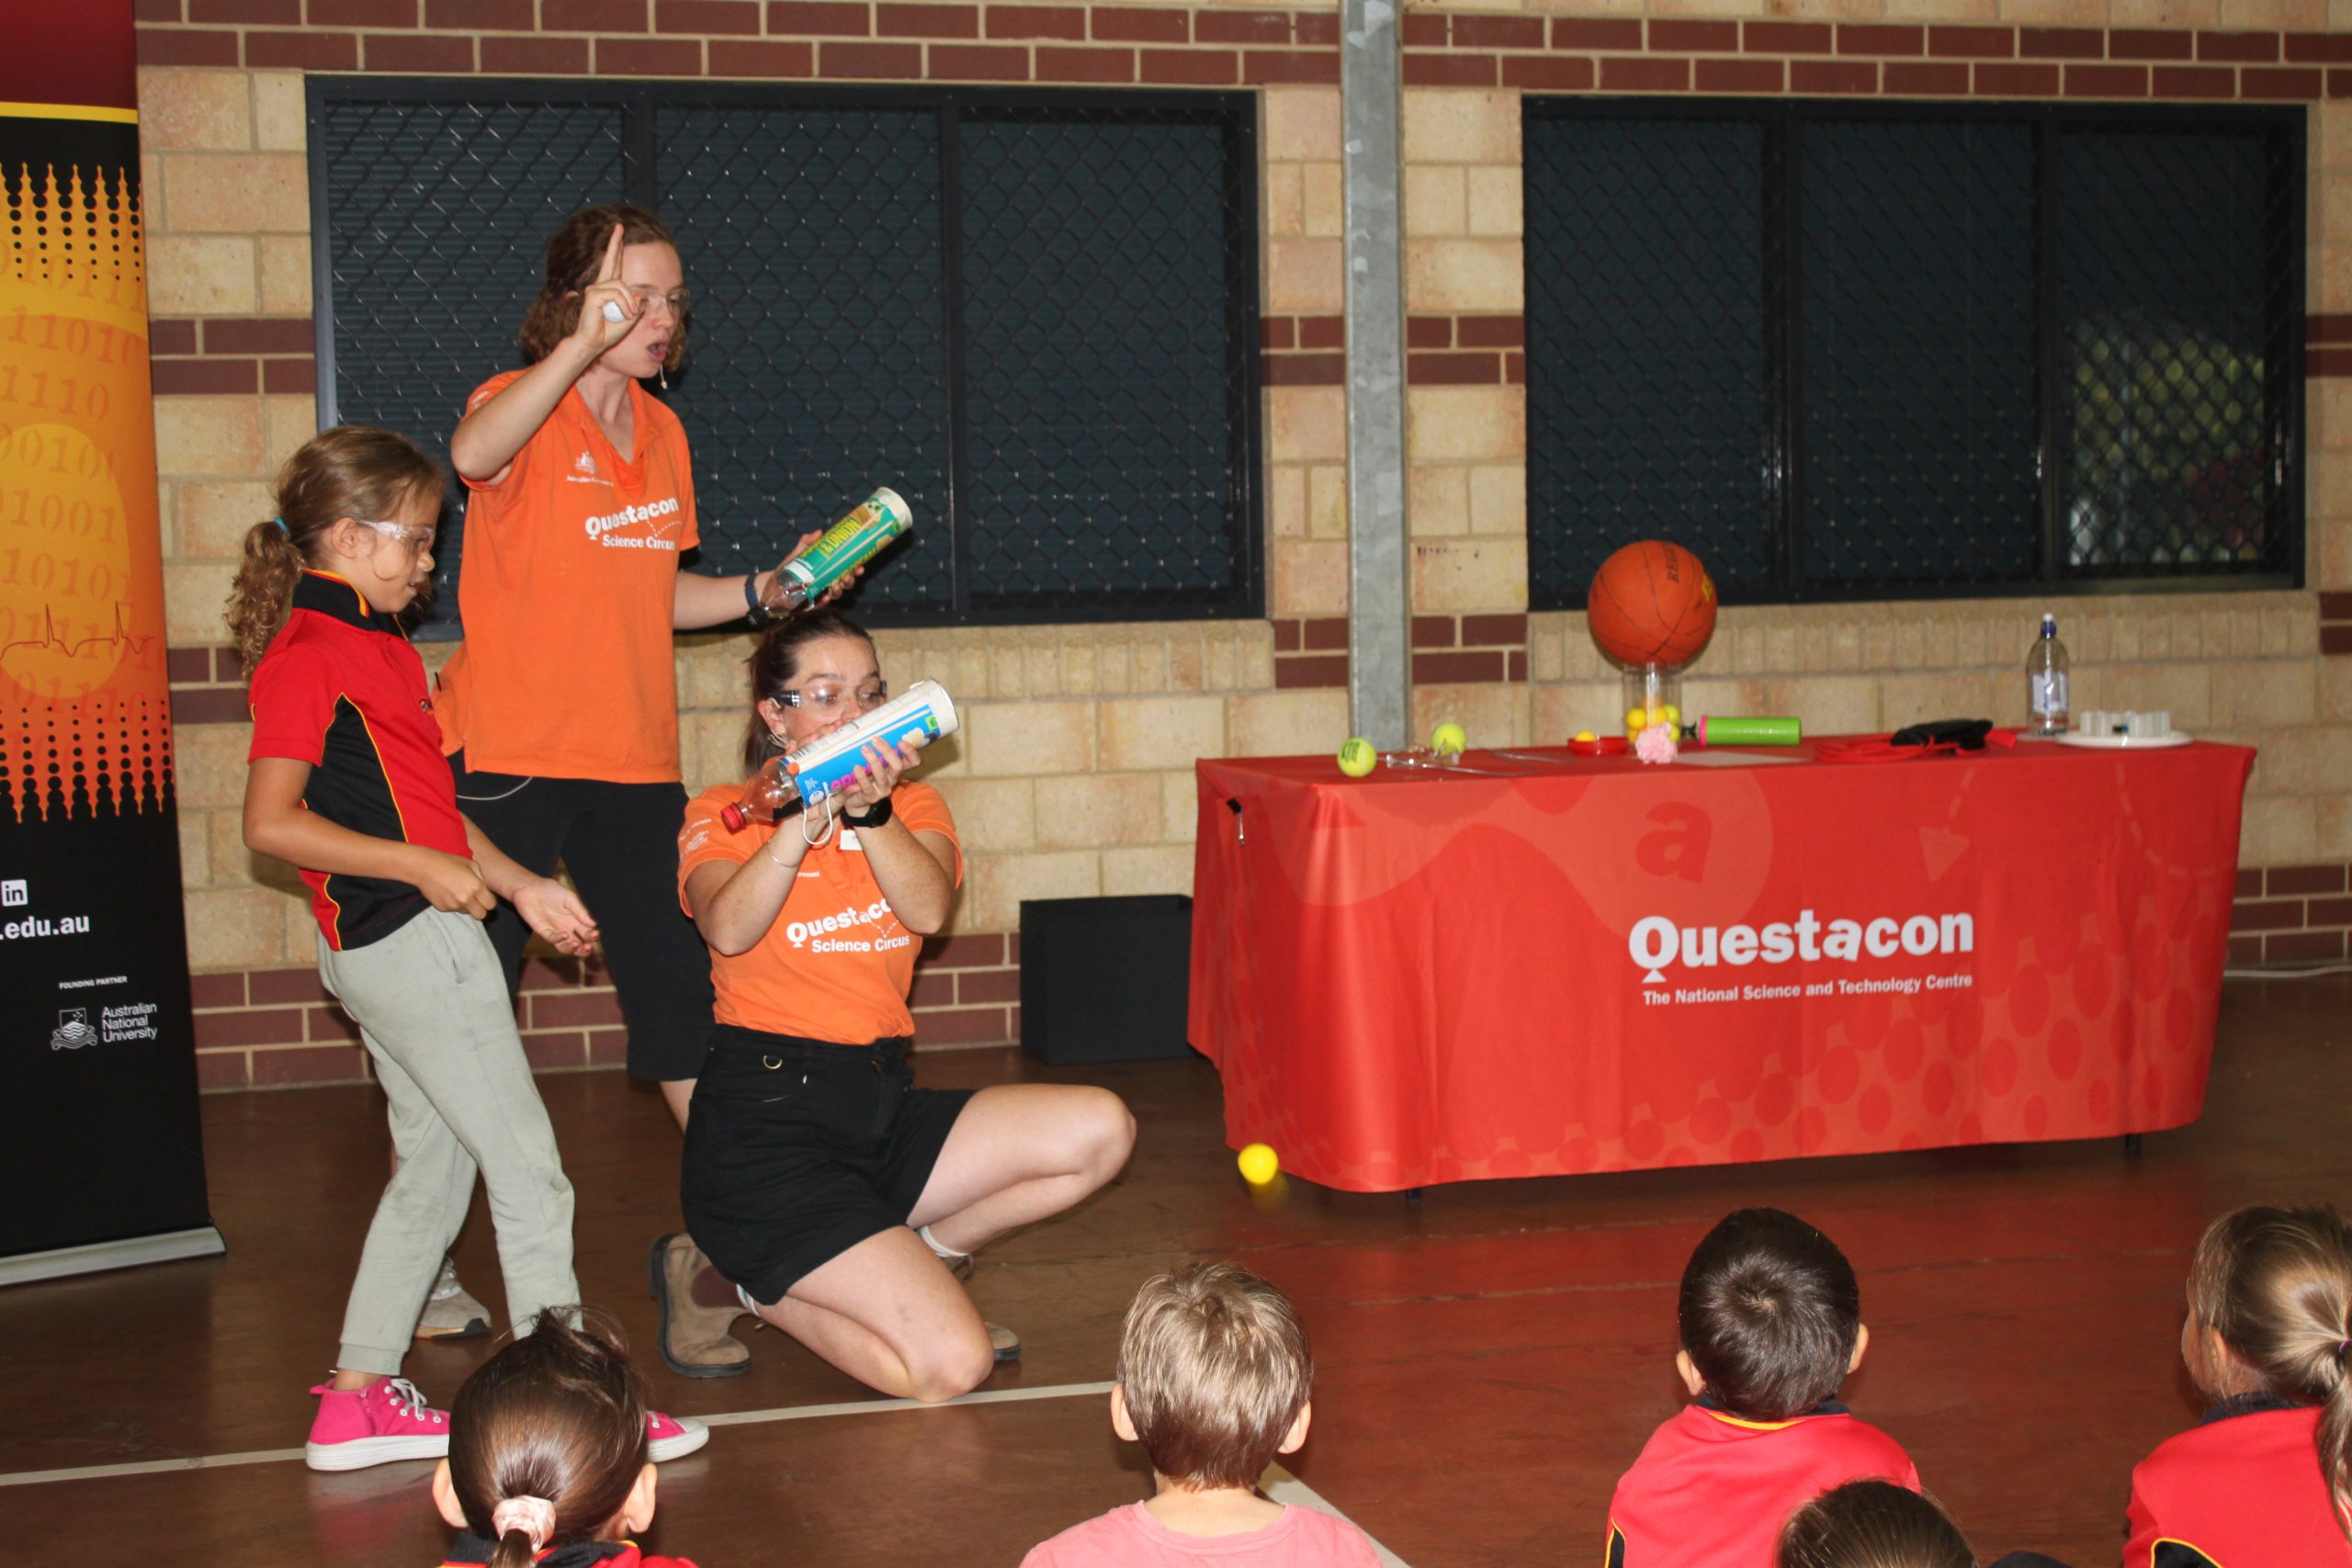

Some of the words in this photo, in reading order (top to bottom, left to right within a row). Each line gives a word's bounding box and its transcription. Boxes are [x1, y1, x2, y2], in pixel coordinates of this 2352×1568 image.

[0, 488, 117, 544] 1001
[585, 496, 679, 540] Questacon
[602, 534, 644, 548] Science
[646, 535, 676, 551] Circus
[811, 937, 871, 953] Science
[875, 934, 911, 952] Circus
[1629, 909, 1973, 984] Questacon
[59, 978, 96, 990] FOUNDING
[96, 975, 129, 987] PARTNER
[1643, 990, 1670, 1006] The
[1675, 986, 1738, 1004] National
[1743, 984, 1801, 1000] Science
[1805, 980, 1833, 997] and
[1838, 976, 1921, 995] Technology
[1926, 974, 1973, 989] Centre
[101, 1002, 157, 1019] Australian
[101, 1014, 150, 1031] National
[102, 1026, 158, 1043] University
